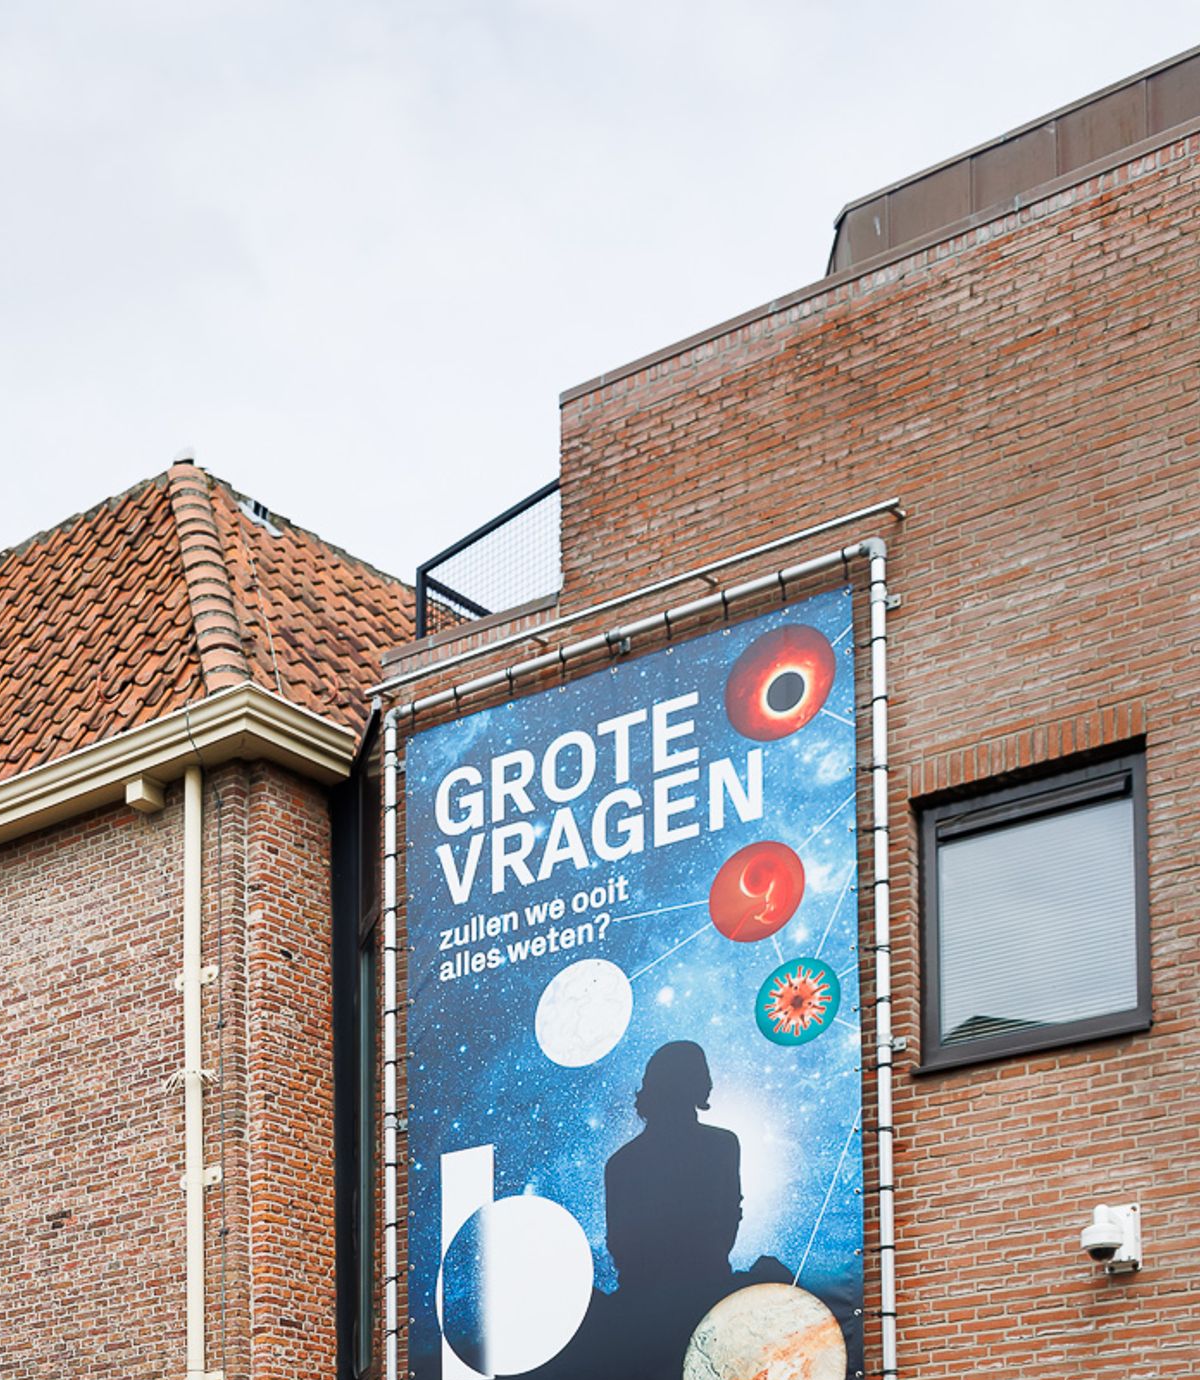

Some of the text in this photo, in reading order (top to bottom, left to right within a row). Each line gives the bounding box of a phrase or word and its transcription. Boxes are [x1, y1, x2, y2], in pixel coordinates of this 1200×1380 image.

[434, 691, 700, 838] GROTE
[435, 748, 765, 906] VRAGEN
[439, 877, 629, 951] zullen we ooit
[439, 913, 611, 982] alles weten?
